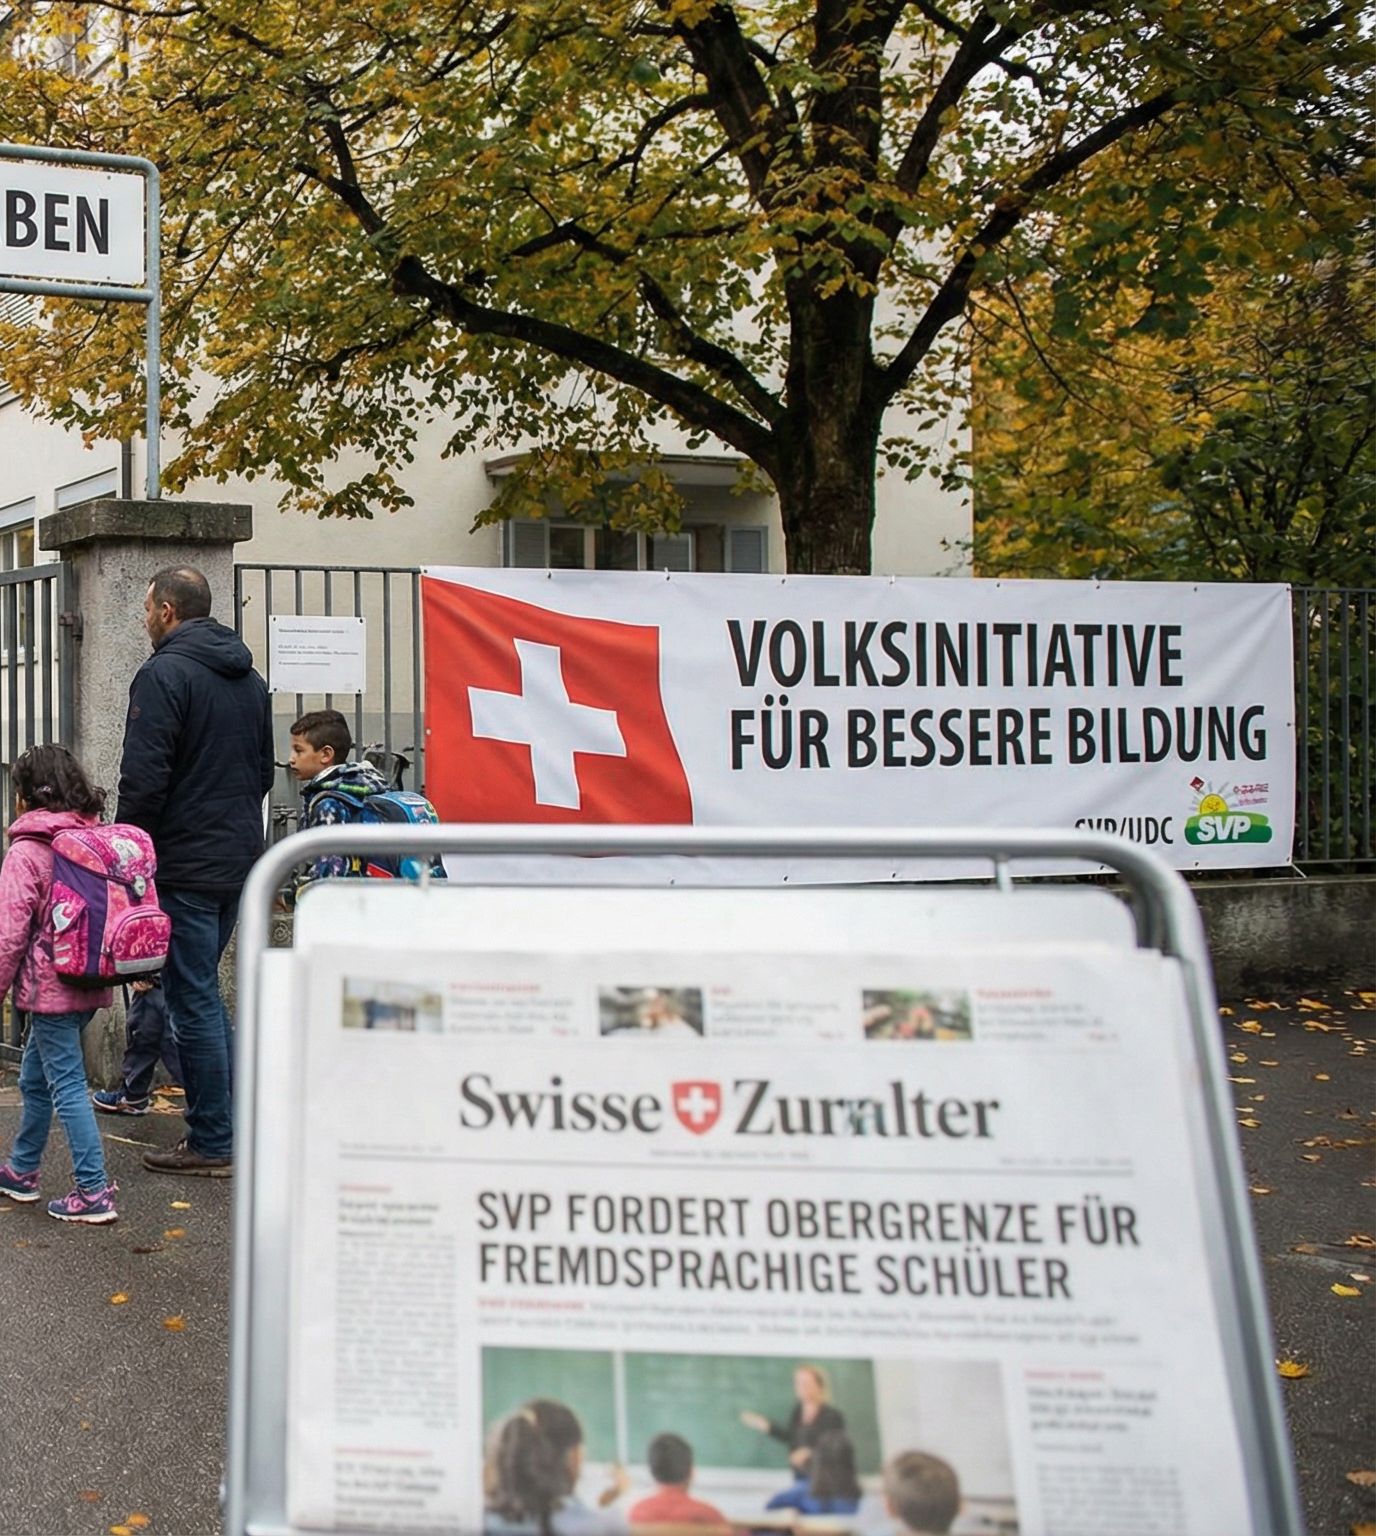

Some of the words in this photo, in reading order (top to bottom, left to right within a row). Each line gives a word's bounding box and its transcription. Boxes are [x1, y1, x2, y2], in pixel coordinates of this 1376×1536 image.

[726, 619, 1184, 688] VOLKSINITIATIVE
[731, 693, 831, 771] FÜR
[847, 707, 1053, 768] BESSERE
[1068, 704, 1267, 765] BILDUNG
[1197, 816, 1251, 842] SVP
[460, 1074, 661, 1133] Swisse
[478, 1192, 552, 1231] SVP
[568, 1194, 749, 1237] FORDERT
[767, 1199, 1042, 1244] OBERGRENZE
[1057, 1194, 1141, 1246] FÜR
[480, 1243, 860, 1294] FREMDSPRACHIGE
[876, 1247, 1071, 1299] SCHÜLER
